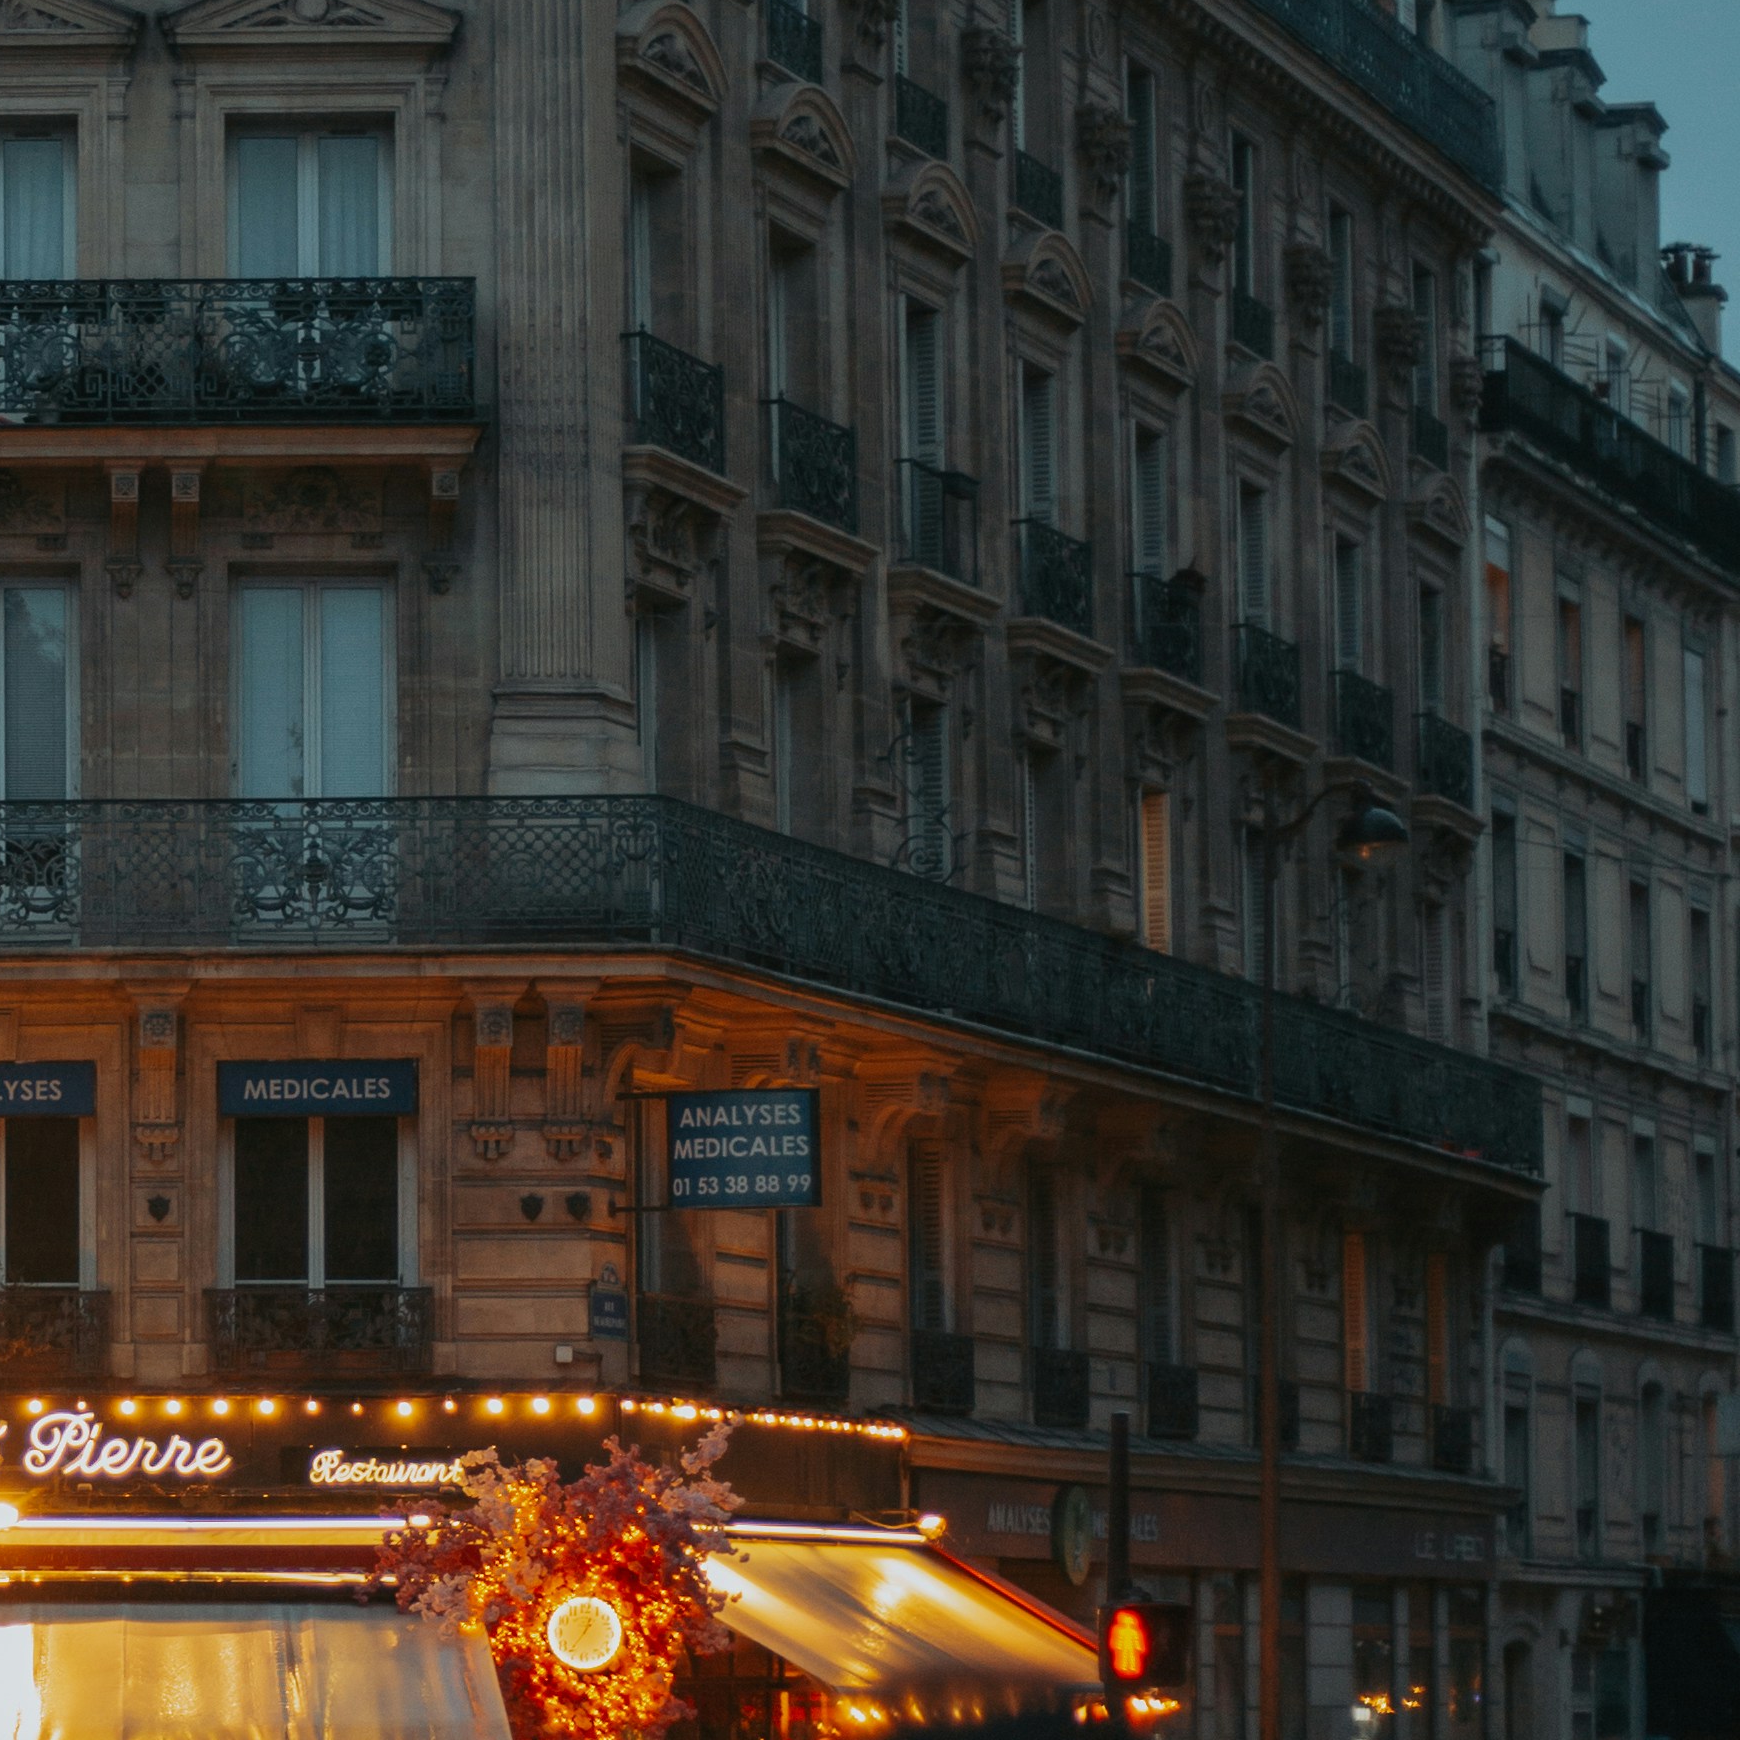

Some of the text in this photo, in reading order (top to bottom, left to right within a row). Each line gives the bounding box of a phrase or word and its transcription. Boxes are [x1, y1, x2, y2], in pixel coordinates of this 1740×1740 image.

[243, 1077, 392, 1101] MEDICALES
[680, 1104, 801, 1128] ANALYSES
[674, 1135, 810, 1160] MEDICALES
[673, 1173, 812, 1197] 01 53 38 88 99
[24, 1411, 233, 1476] Pierre
[310, 1449, 466, 1483] Restaurant
